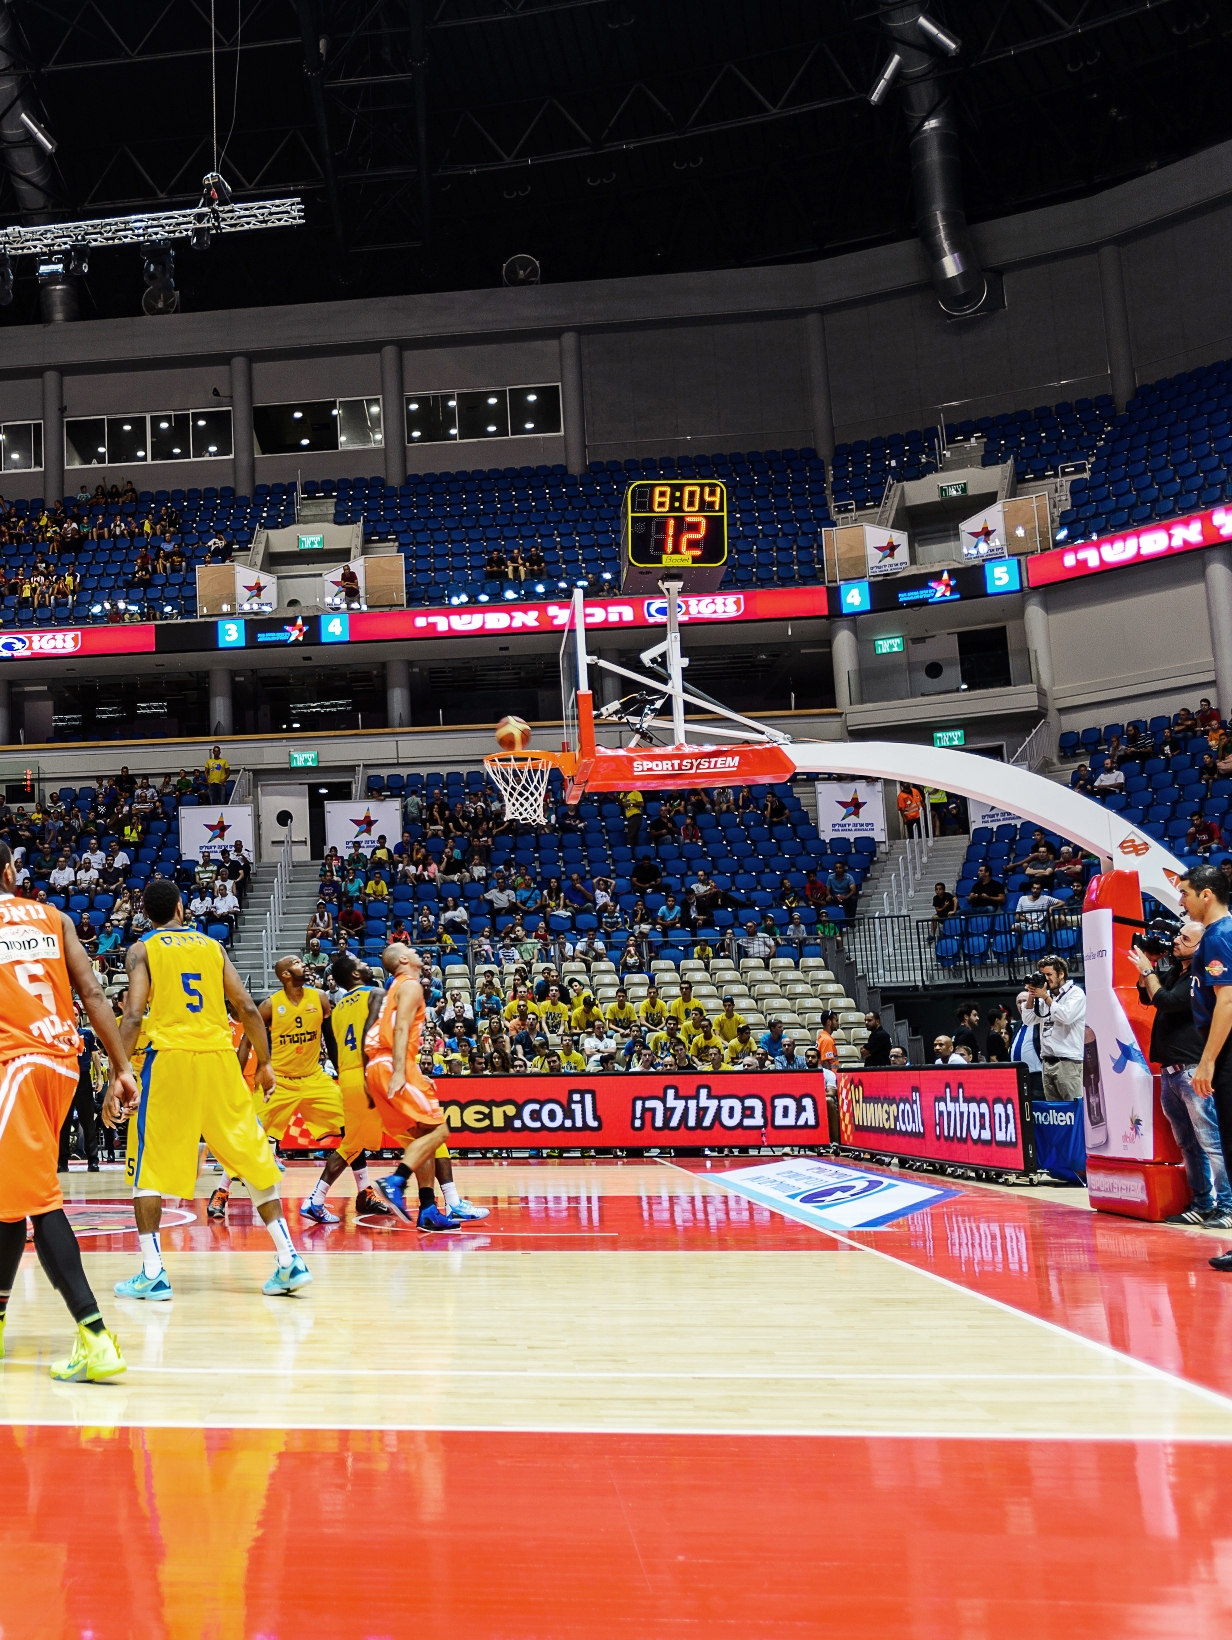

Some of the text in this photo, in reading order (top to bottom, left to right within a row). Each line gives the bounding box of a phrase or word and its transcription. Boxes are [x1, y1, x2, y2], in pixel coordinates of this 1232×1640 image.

[653, 485, 721, 512] 8:04
[665, 516, 706, 557] 12
[1063, 519, 1203, 568] אפשרי
[993, 565, 1009, 586] 5
[846, 588, 861, 606] 4
[328, 618, 342, 636] 4
[414, 610, 540, 632] אפשרי
[225, 623, 238, 641] 3
[877, 639, 902, 653] יציאה
[936, 731, 962, 747] יציאה
[293, 753, 315, 767] יציאה
[42, 936, 56, 948] חי
[181, 972, 204, 1013] 5
[295, 1016, 303, 1029] 9
[279, 1030, 318, 1046] אלקטרה
[344, 1024, 358, 1051] 4
[442, 1093, 599, 1128] ner.co.il
[774, 1097, 816, 1126] גם
[851, 1084, 924, 1133] Winner.co.il
[993, 1101, 1017, 1143] גם
[127, 1158, 135, 1177] 5
